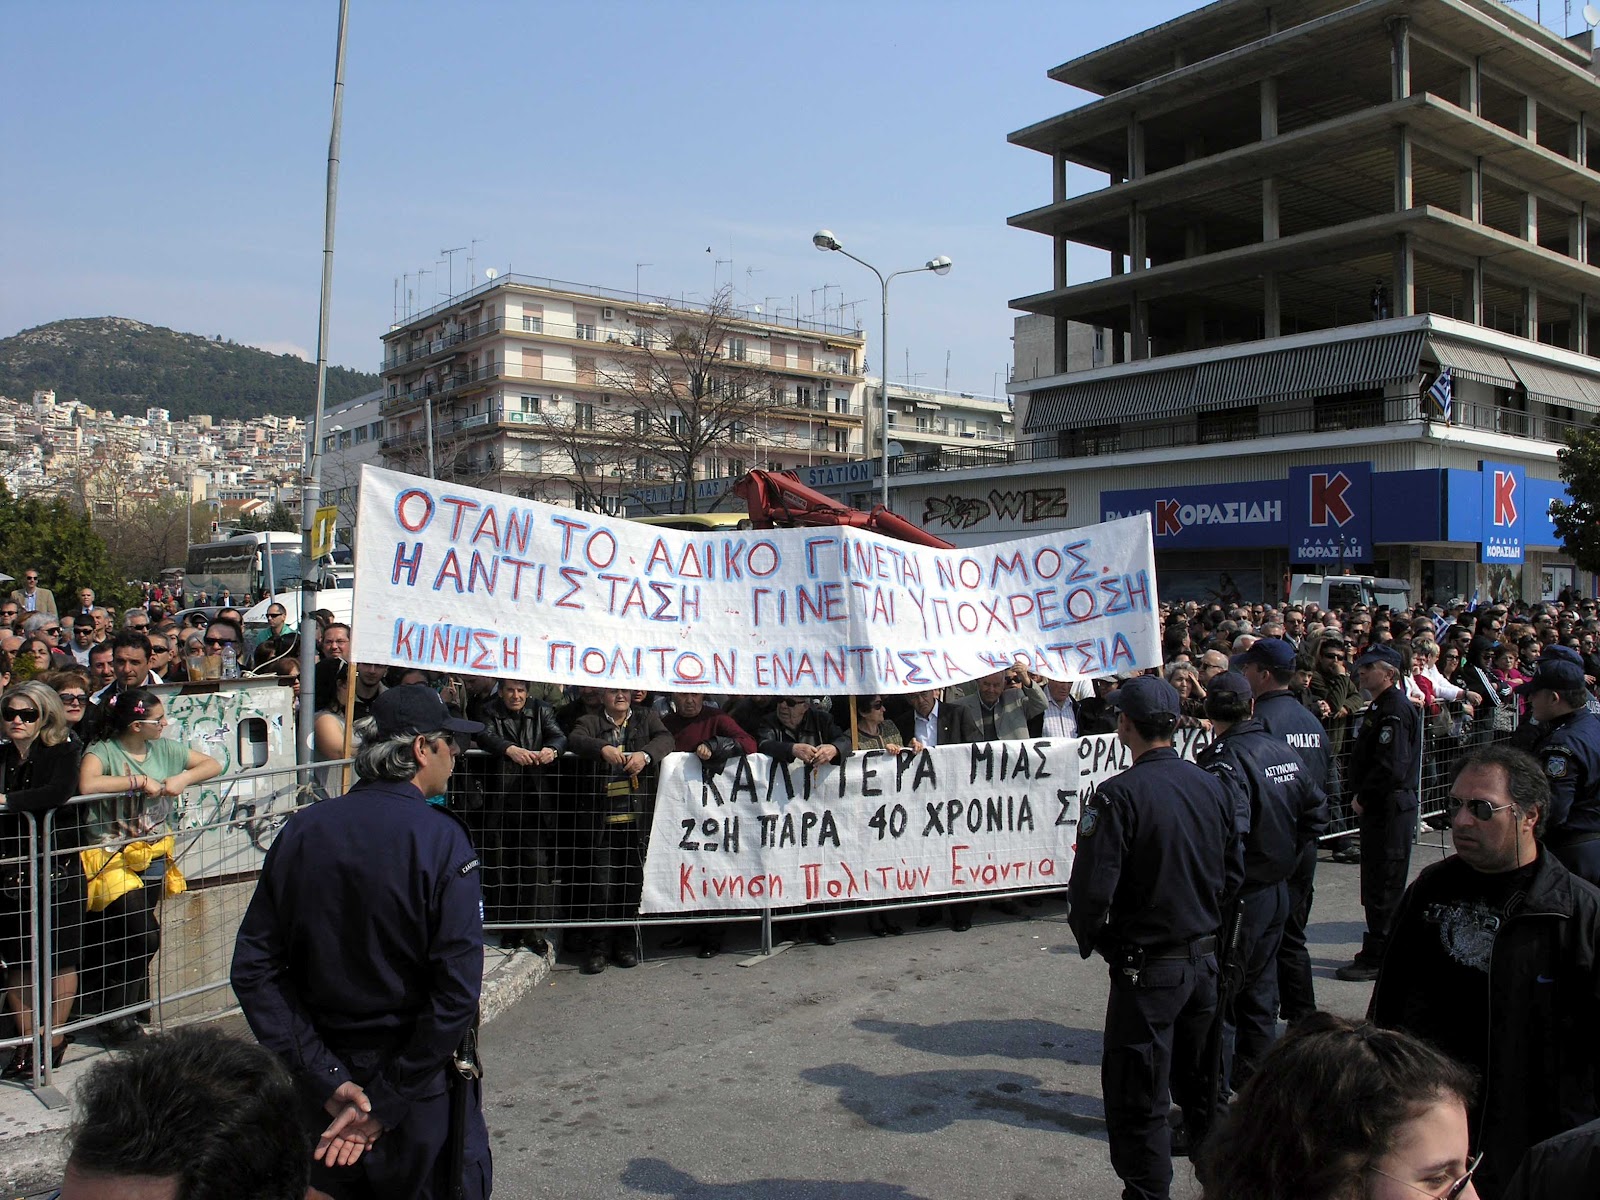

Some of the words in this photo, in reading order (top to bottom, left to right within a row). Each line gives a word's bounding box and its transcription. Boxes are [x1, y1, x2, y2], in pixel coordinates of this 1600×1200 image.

[809, 463, 869, 485] STATION
[988, 489, 1069, 523] WIZ
[1155, 498, 1281, 536] ΚΟΡΑΣΙΔΗ
[1309, 471, 1355, 527] Κ
[1493, 471, 1517, 527] Κ
[395, 487, 533, 555] ΟΤΑΝ
[551, 514, 618, 570] ΤΟ
[644, 536, 781, 584] ΑΔΙΚΟ
[805, 536, 921, 587] ΓΙΝΕΤΑΙ
[1304, 537, 1357, 545] ΡΑΔΟ
[1486, 545, 1520, 558] ΚΟΡΑΣΙΔΗ
[1490, 536, 1518, 545] ΡΑΔΙΟ
[392, 542, 423, 586] Η
[433, 546, 700, 622] ΑΝΤΙΣΤΑΣΗ
[752, 581, 895, 627] ΓΙΝΕΤΑΙ
[392, 618, 520, 671] ΚΙΝΗΣΗ
[547, 640, 736, 686] ΠΟΛΙΤΩΝ
[899, 646, 970, 685] ΣΤΑ
[1286, 734, 1320, 748] POLICE
[970, 741, 1051, 784] ΜΙΑΣ
[1264, 762, 1300, 778] ΑΣΤΥΝΟΜΙΑ
[1273, 773, 1295, 784] POLICE
[678, 815, 739, 853] ΖΩΗ
[757, 810, 840, 849] ΠΑΡΑ
[868, 803, 908, 841] 40
[922, 794, 1034, 837] ΧΡΟΝΙΑ
[679, 862, 783, 904] Κίνηση
[800, 858, 930, 900] Πολιτών
[952, 845, 1054, 885] Ενάντια
